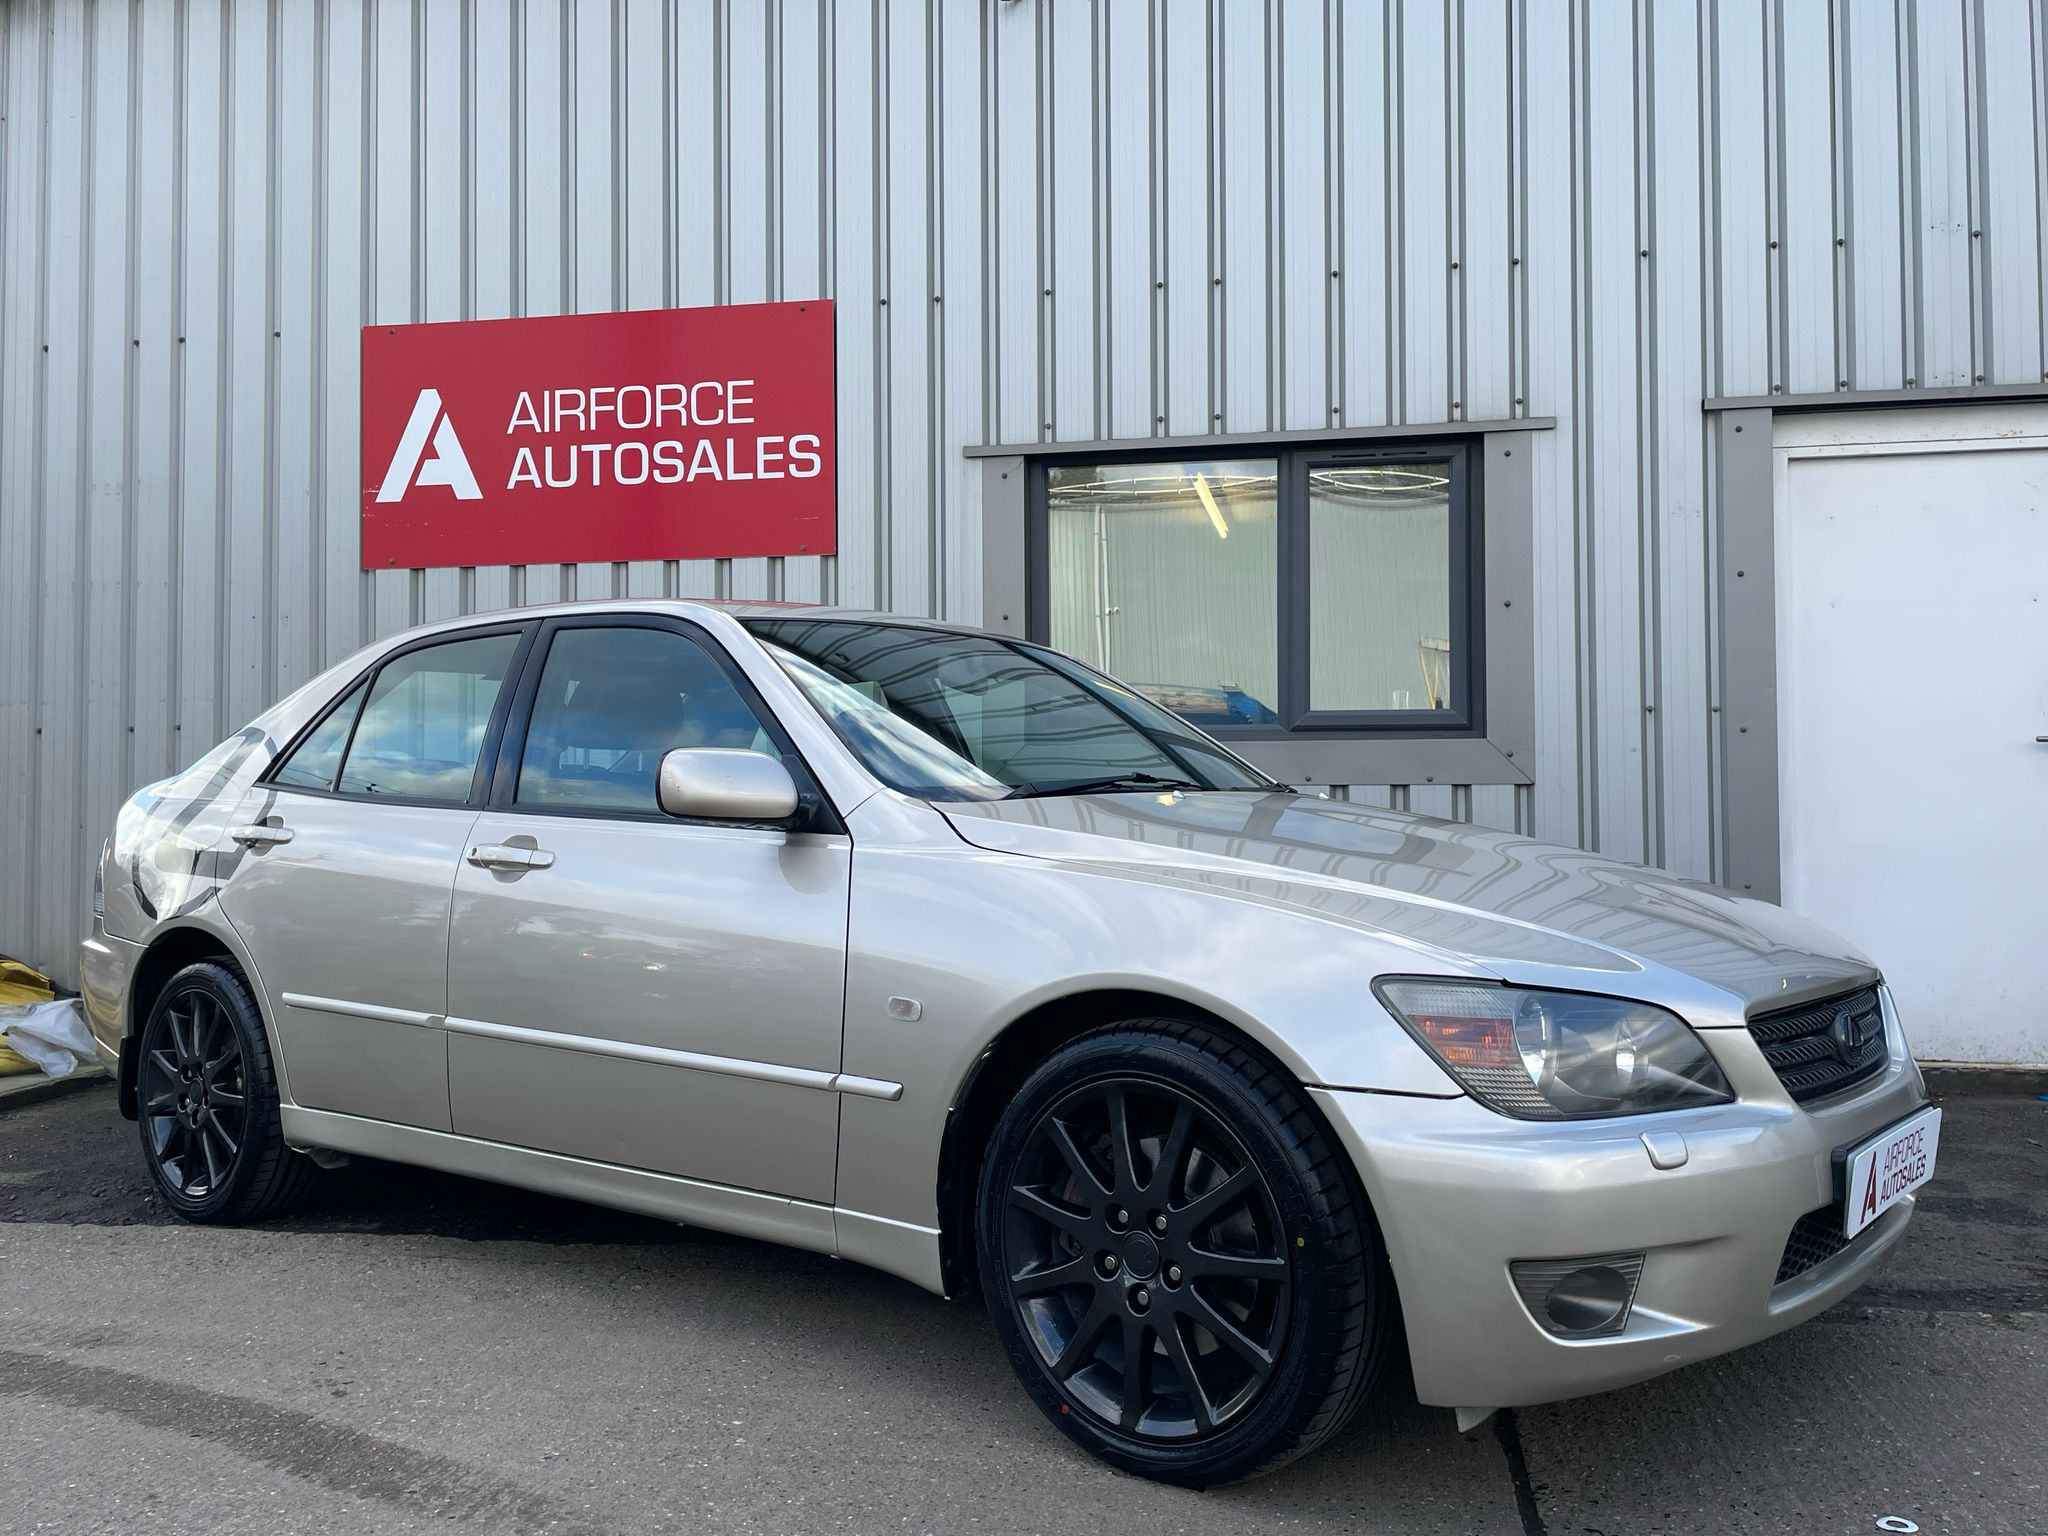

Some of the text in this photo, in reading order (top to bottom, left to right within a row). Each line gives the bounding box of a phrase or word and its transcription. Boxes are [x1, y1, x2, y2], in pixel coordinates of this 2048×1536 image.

[507, 379, 755, 434] AIRFORCE
[507, 434, 822, 490] AUTOSALES
[1882, 1127, 1925, 1175] AIRFORCE
[1880, 1154, 1926, 1205] AUTOSALES
